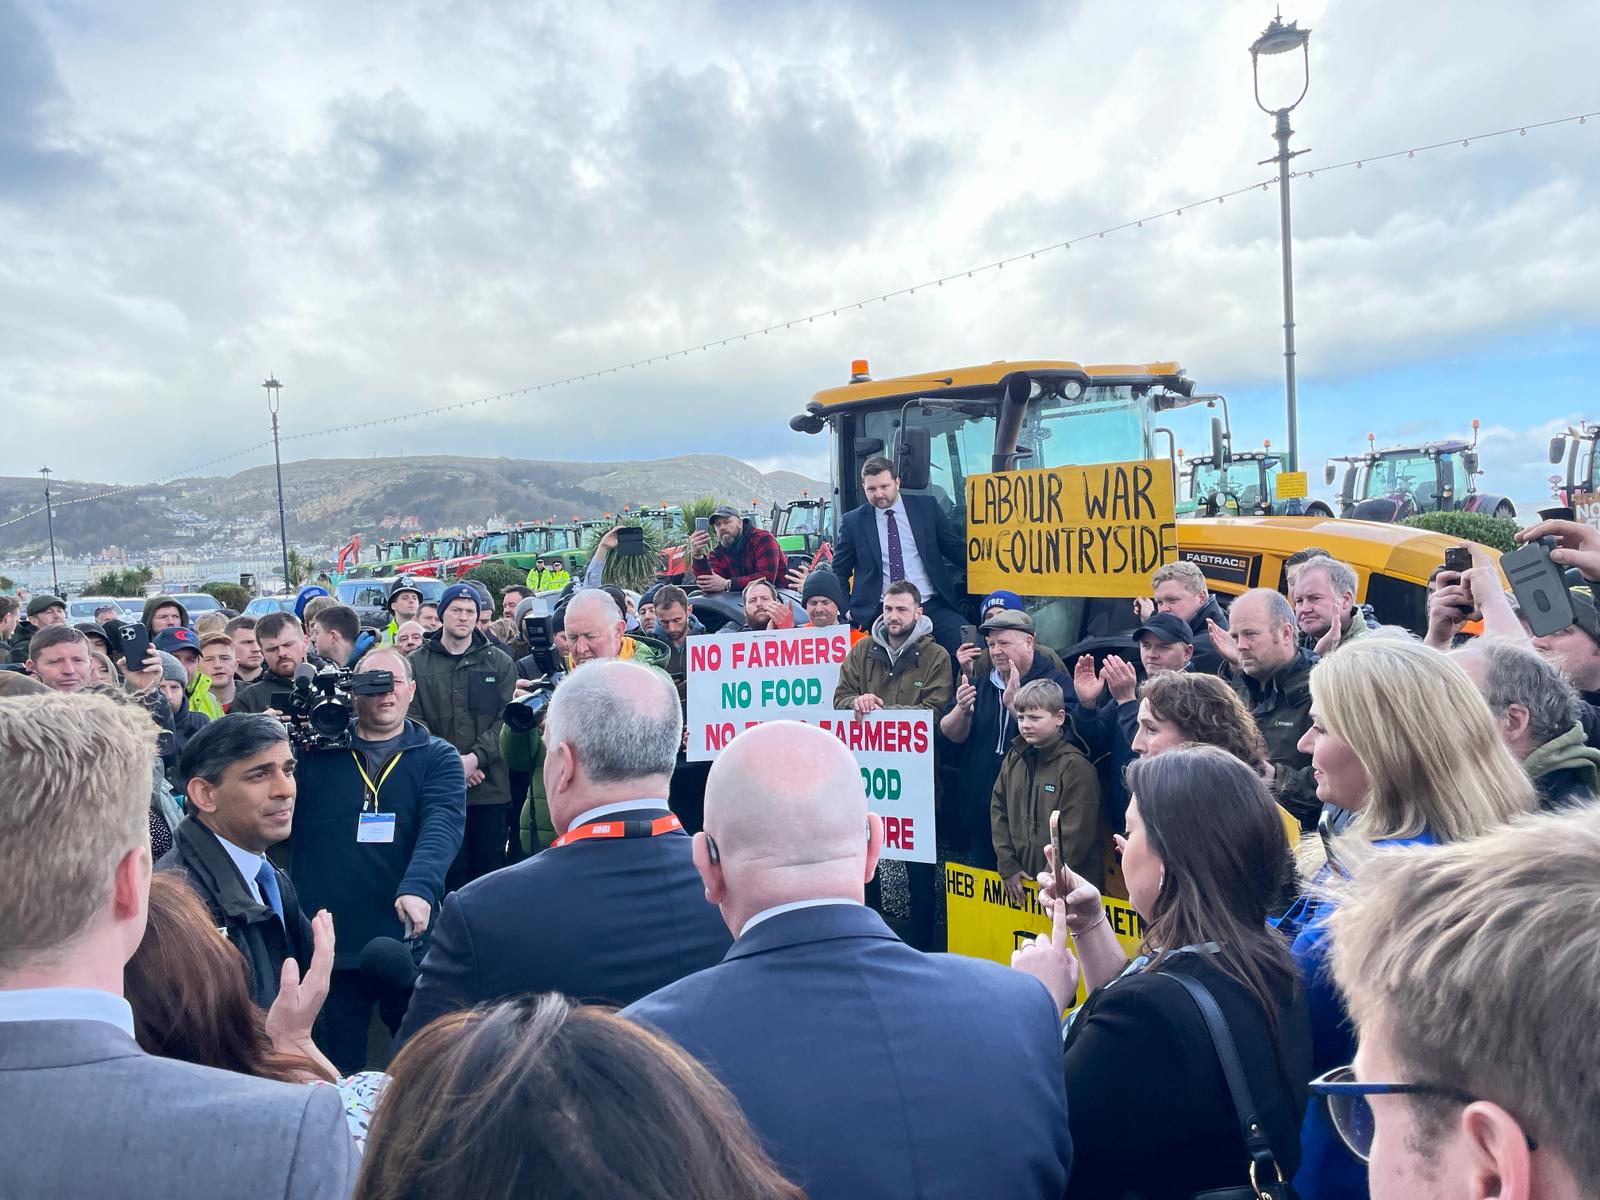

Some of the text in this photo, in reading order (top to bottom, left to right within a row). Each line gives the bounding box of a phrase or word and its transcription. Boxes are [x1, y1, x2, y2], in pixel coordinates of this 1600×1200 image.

[970, 465, 1156, 524] LABOUR WAR
[969, 523, 1178, 575] ON COUNTRYSIDE
[691, 635, 847, 672] NO FARMERS
[721, 678, 823, 709] NO FOOD
[705, 722, 736, 751] NO
[819, 720, 928, 753] ARMERS
[861, 767, 901, 800] OOD
[947, 869, 974, 898] HEB
